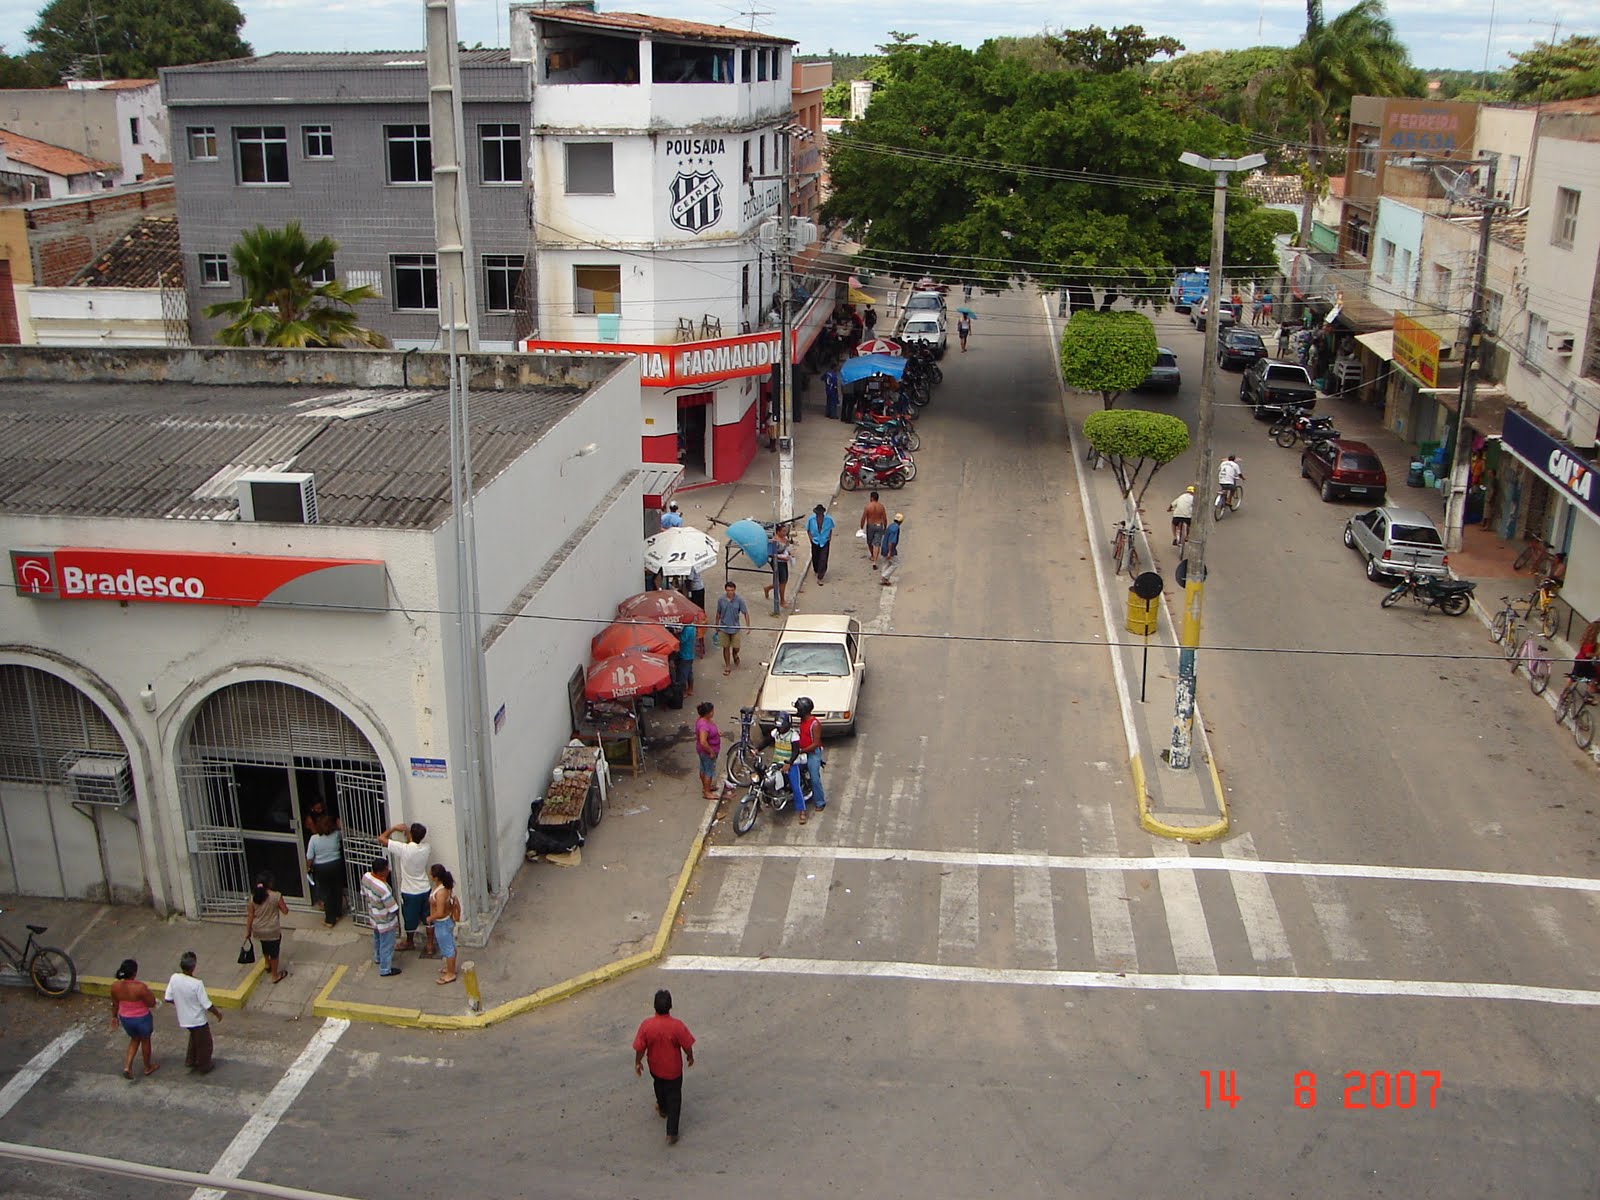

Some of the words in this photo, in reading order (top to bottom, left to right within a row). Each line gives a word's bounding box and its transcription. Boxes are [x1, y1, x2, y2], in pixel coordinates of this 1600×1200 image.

[666, 139, 725, 155] POUSADA
[1548, 449, 1592, 501] CAIXA
[63, 566, 205, 599] Bradesco
[612, 687, 638, 697] Kaiser
